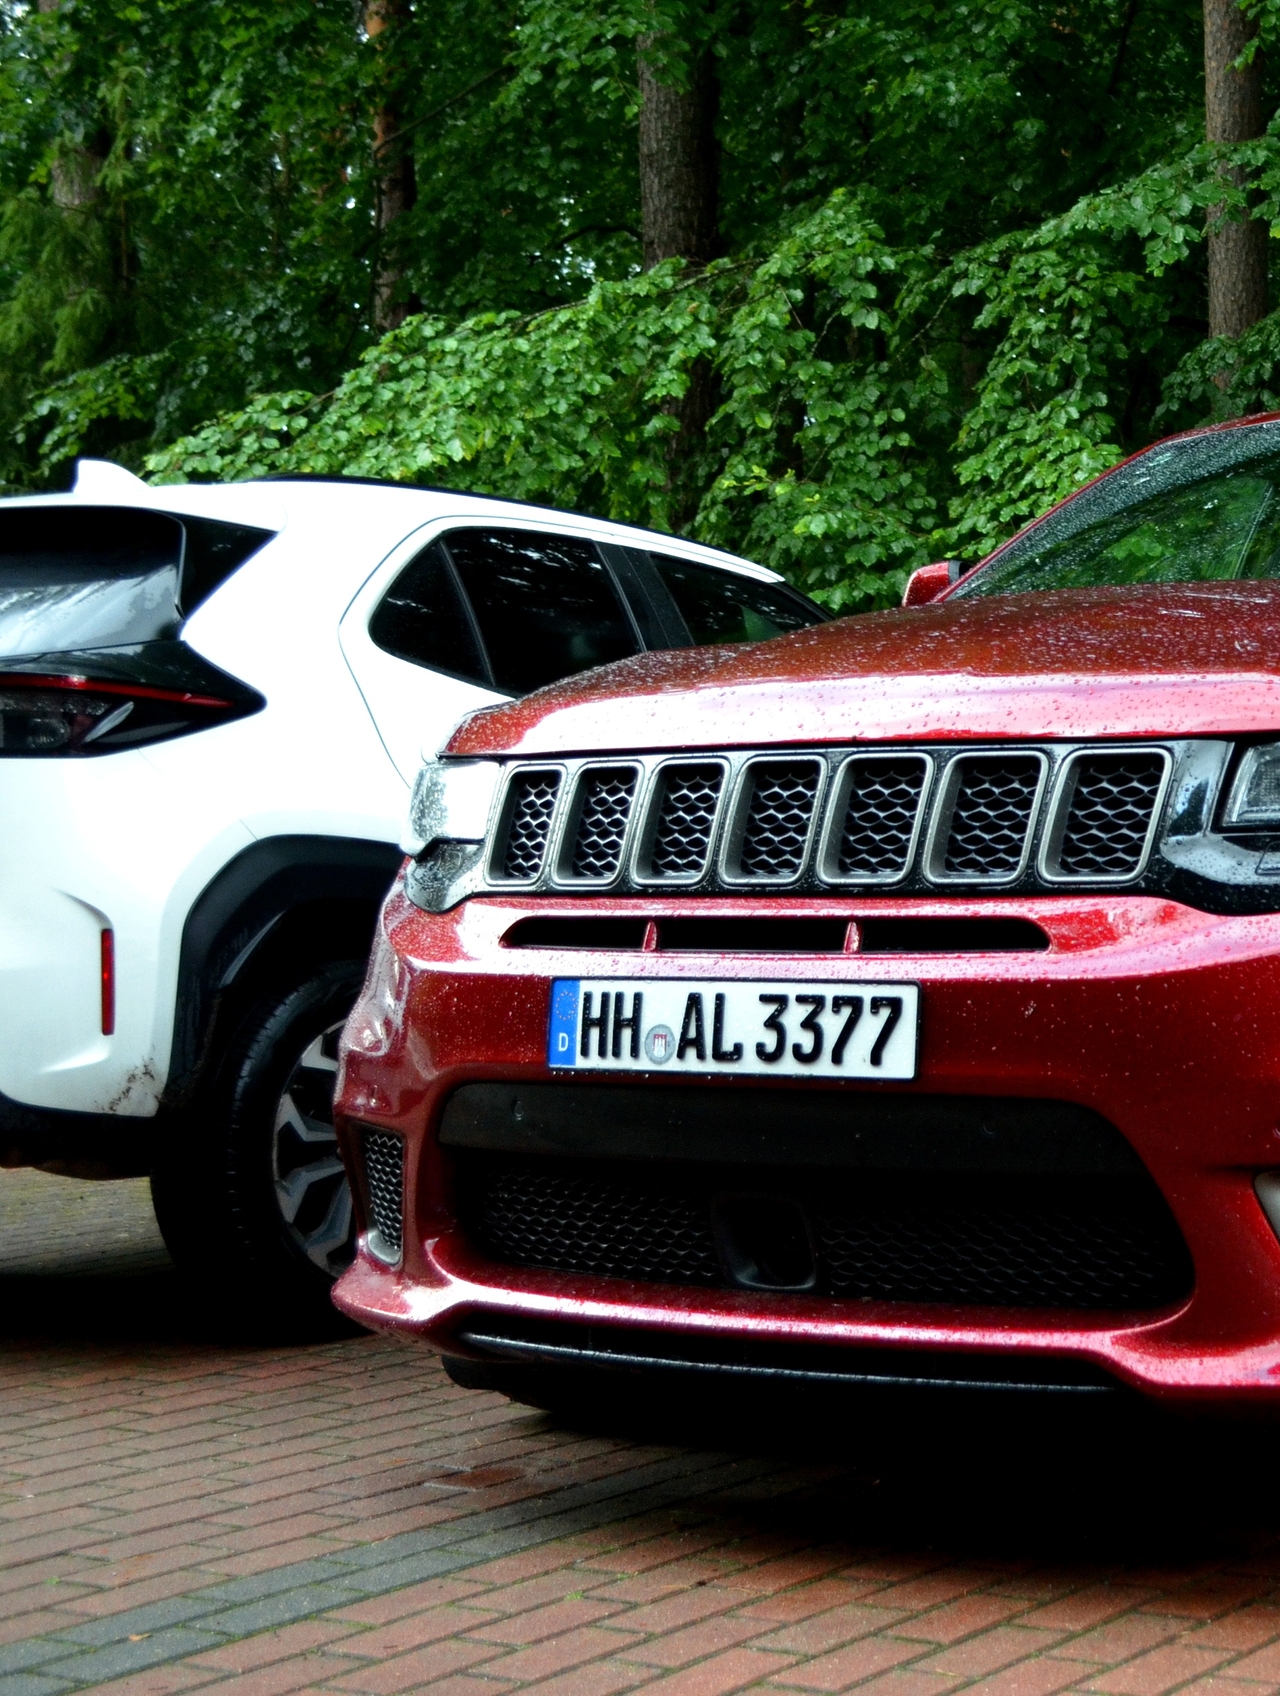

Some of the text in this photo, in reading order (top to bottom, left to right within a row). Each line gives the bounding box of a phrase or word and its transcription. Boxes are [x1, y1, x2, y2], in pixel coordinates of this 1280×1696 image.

[558, 1033, 569, 1052] D
[580, 991, 903, 1067] HH AL 3377
